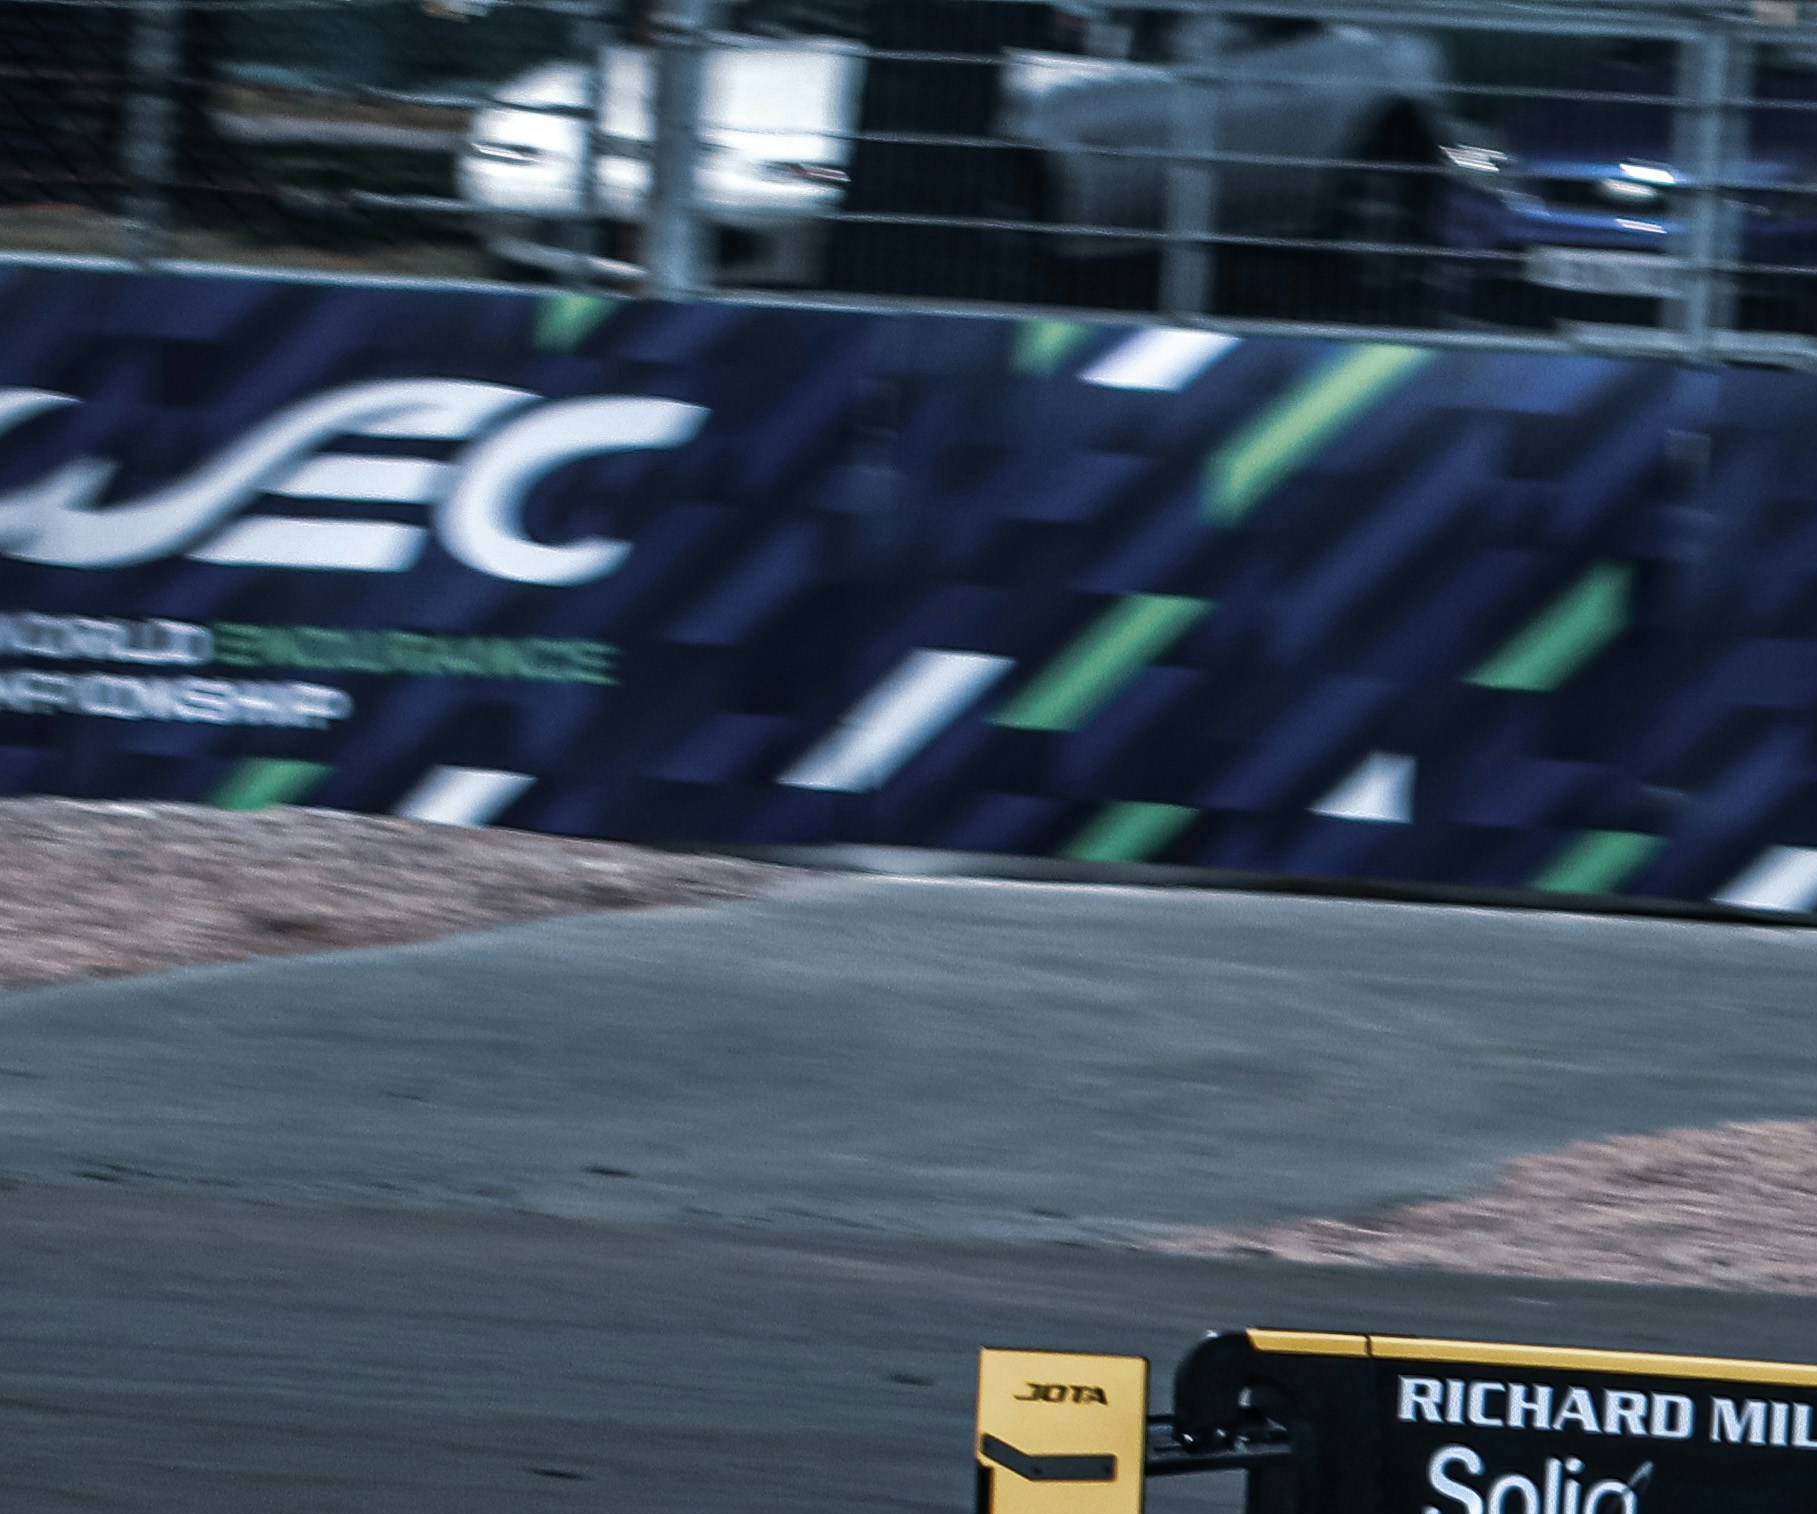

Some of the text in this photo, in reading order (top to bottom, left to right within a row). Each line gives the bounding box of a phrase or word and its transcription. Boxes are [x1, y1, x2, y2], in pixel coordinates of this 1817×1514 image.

[211, 619, 622, 688] ENDURANCE
[0, 667, 354, 731] PIONSHIP
[1014, 1382, 1110, 1406] JOTA
[1396, 1374, 1698, 1442] RICHARD
